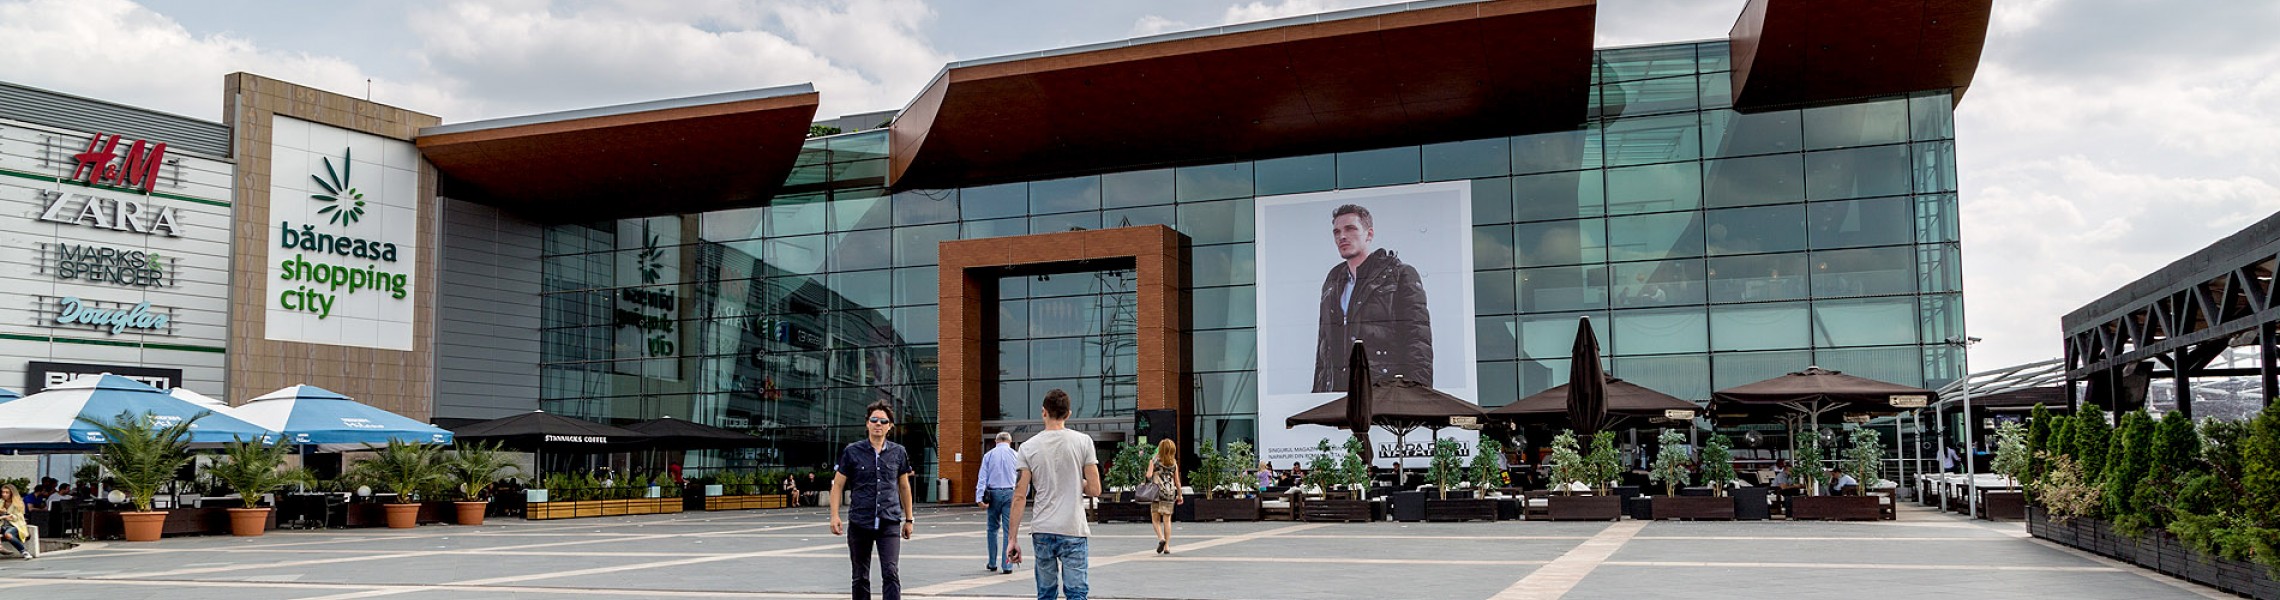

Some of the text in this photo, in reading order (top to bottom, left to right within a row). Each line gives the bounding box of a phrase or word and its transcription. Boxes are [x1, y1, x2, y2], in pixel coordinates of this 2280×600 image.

[73, 132, 167, 193] H&M
[40, 189, 183, 237] ZARA
[61, 243, 163, 270] MARKS &
[281, 221, 397, 262] băneasa
[59, 261, 163, 287] SPENCER
[281, 253, 408, 299] shopping
[57, 296, 170, 336] Douglas
[280, 285, 335, 319] city
